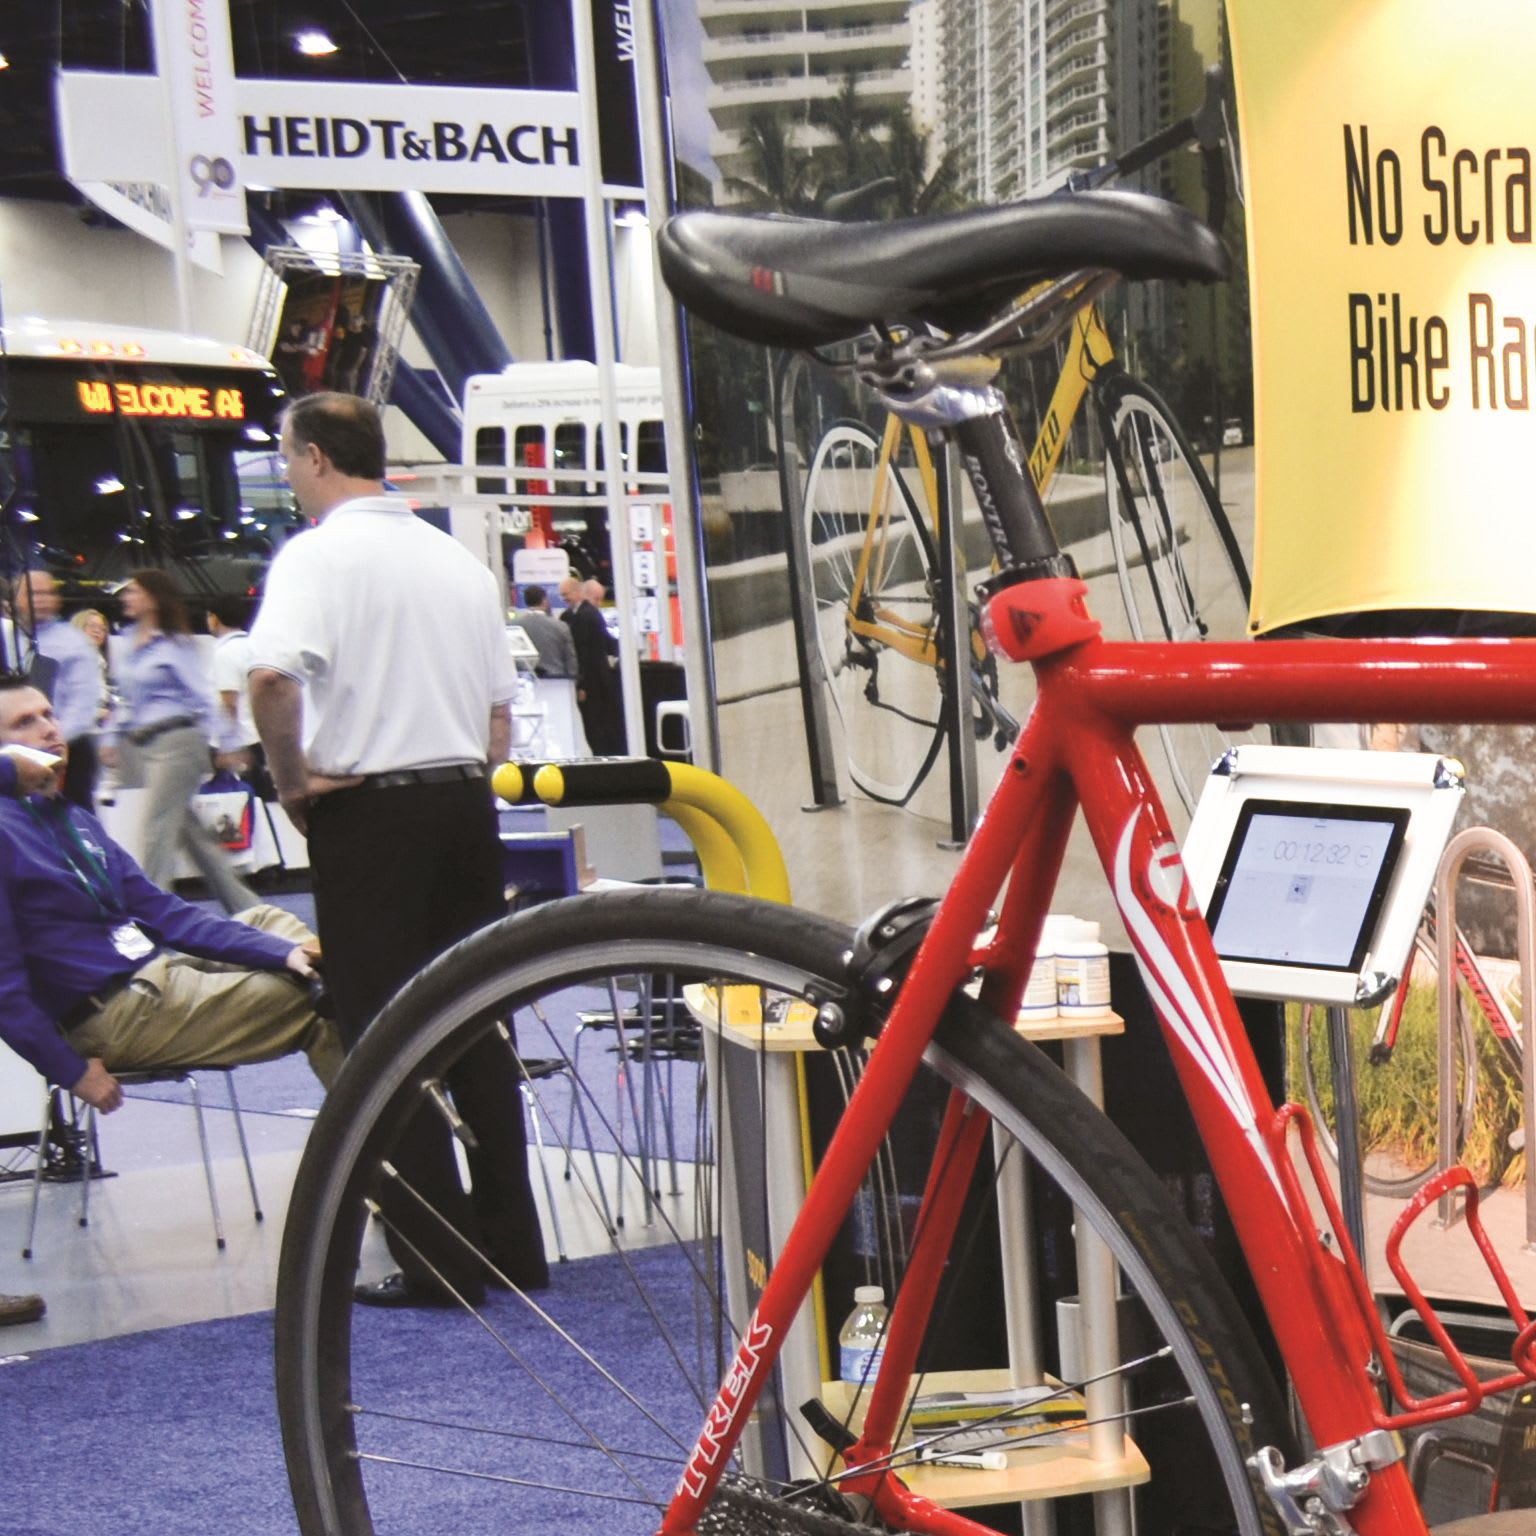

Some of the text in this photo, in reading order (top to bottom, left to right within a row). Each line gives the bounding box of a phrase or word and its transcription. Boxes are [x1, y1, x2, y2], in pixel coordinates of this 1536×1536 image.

[1343, 123, 1404, 246] No
[1347, 292, 1450, 414] Bike
[675, 1308, 773, 1499] TREK
